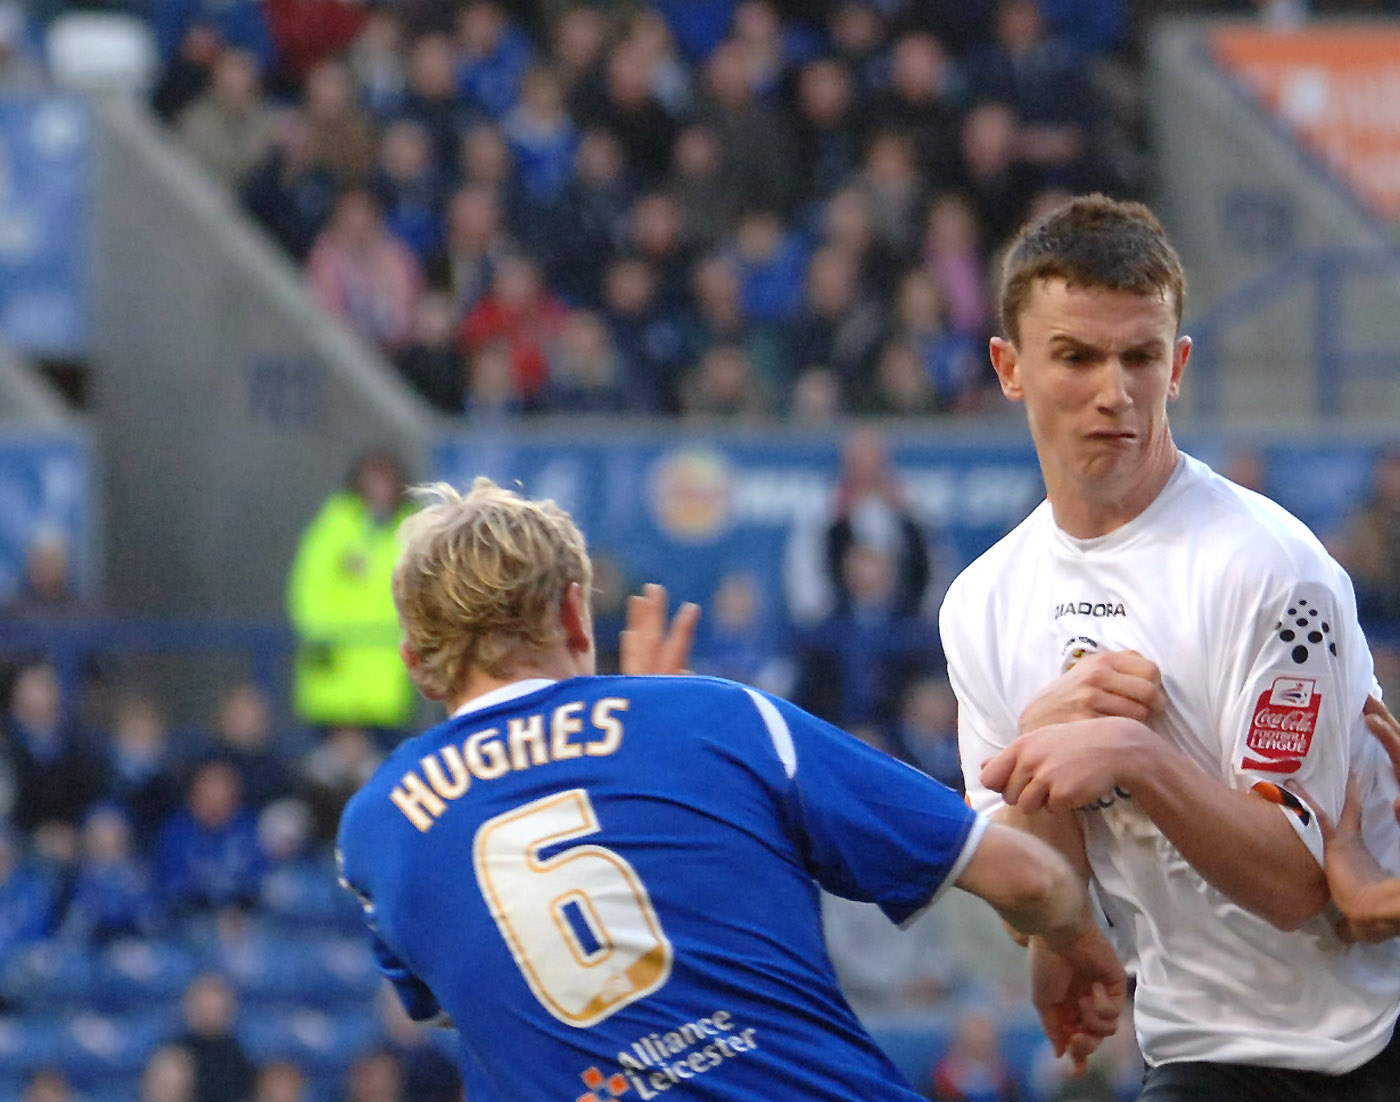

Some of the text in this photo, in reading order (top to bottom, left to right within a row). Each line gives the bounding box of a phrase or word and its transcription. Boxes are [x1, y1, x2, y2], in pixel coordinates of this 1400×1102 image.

[390, 697, 630, 833] HUGHES
[473, 789, 674, 1028] 6
[617, 1010, 736, 1076] Alliance
[628, 1028, 758, 1101] Leicester
